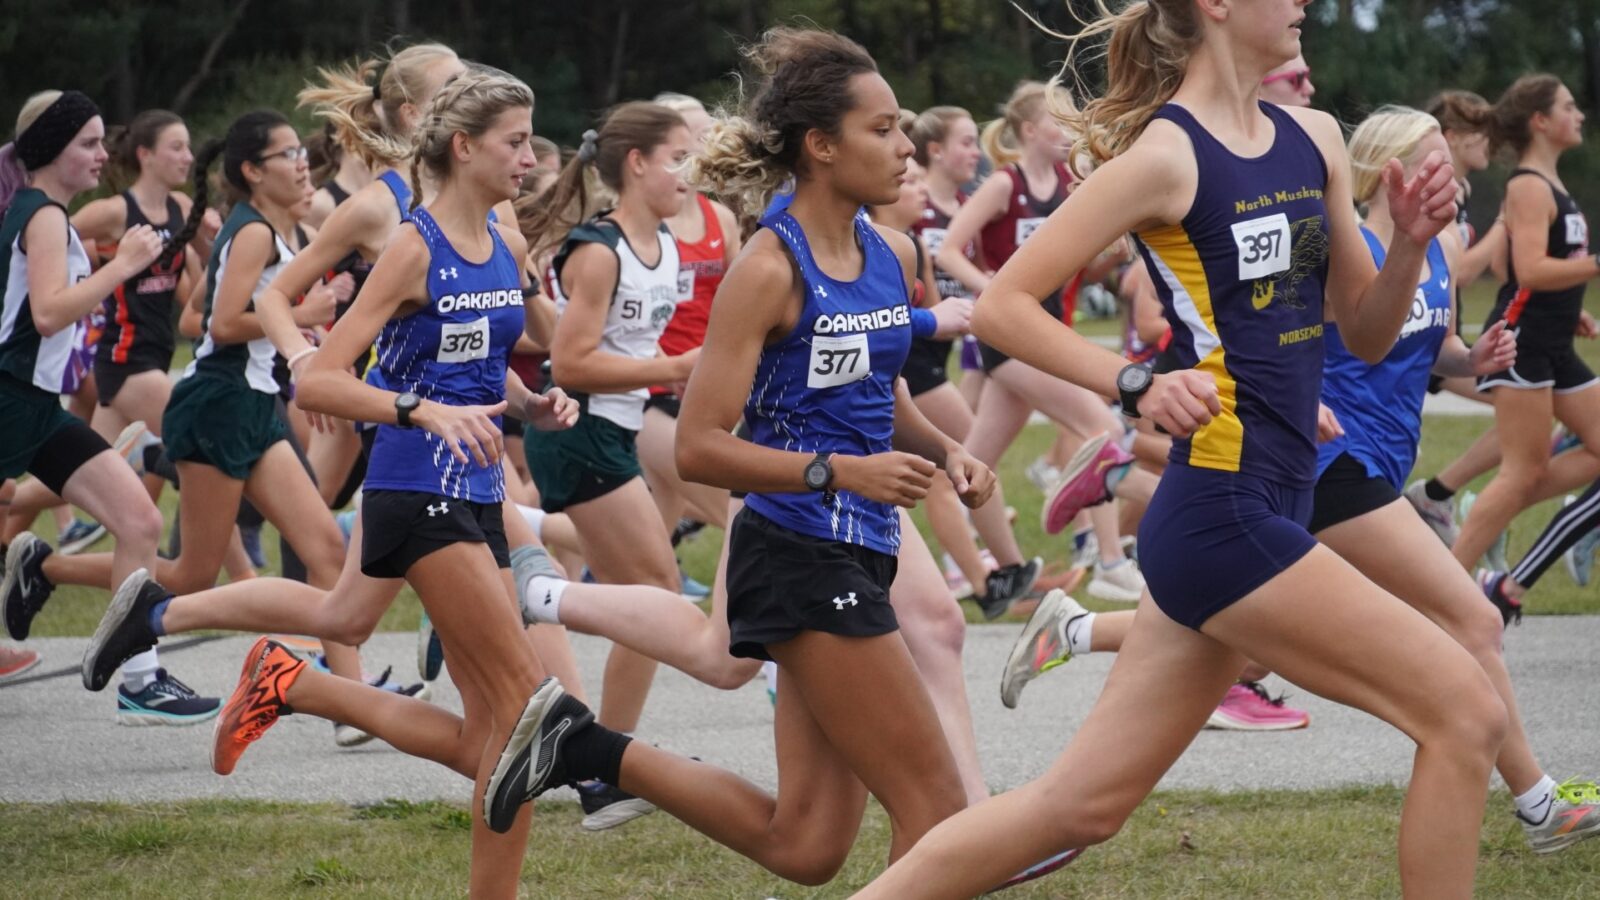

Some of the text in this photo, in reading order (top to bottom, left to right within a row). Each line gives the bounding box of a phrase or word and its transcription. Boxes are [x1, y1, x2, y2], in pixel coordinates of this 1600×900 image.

[1235, 195, 1273, 214] North
[1241, 228, 1282, 264] 397
[437, 289, 524, 313] OAKRIDGE
[621, 300, 642, 319] 51
[813, 304, 910, 334] OAKRIDGE
[441, 330, 484, 353] 378
[813, 347, 862, 375] 377
